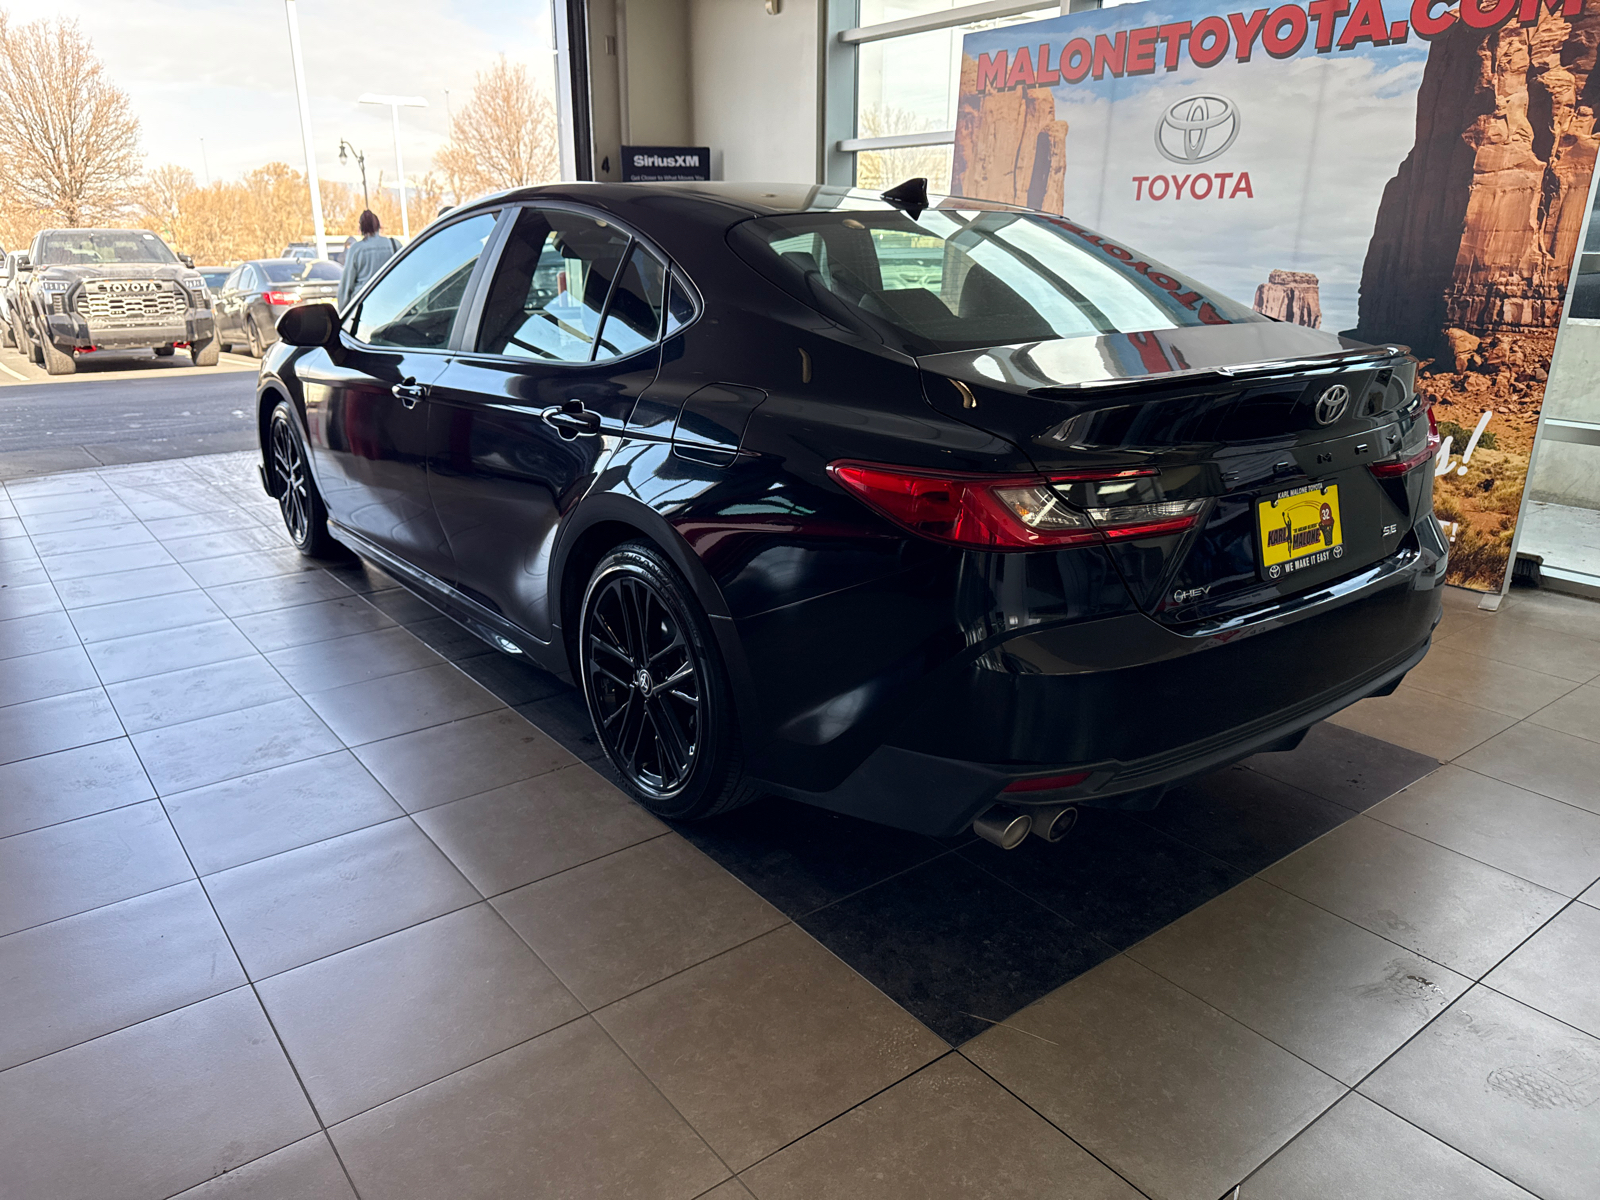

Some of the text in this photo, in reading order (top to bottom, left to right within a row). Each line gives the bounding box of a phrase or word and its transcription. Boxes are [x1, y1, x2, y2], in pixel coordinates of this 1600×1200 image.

[633, 155, 700, 168] SiriusXM
[1132, 172, 1254, 201] TOYOTA
[103, 283, 158, 292] TOYOTA
[1277, 491, 1290, 500] KARL
[1290, 487, 1308, 497] MALONE
[1321, 508, 1330, 520] 32
[1267, 526, 1287, 548] KARL
[1383, 523, 1397, 537] SE
[1292, 527, 1321, 550] MALONE
[1284, 551, 1330, 573] WE MAKE IT EASY
